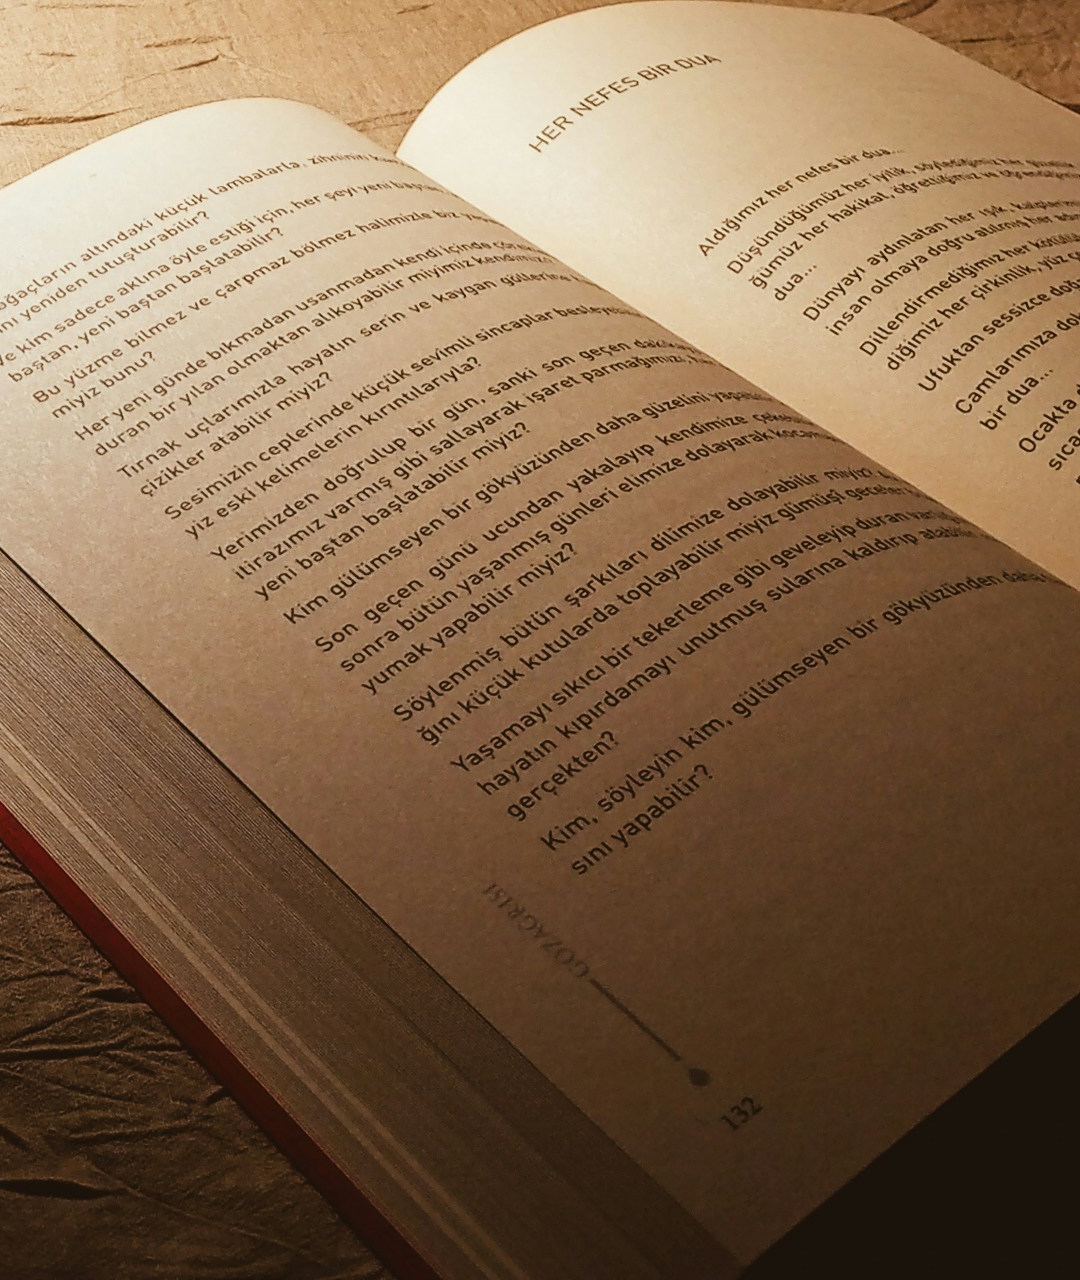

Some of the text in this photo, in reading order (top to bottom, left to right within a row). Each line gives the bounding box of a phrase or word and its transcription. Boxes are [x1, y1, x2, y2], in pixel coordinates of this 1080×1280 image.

[529, 51, 722, 153] HER NEFES BİR DUA
[153, 193, 209, 222] küçük
[698, 179, 794, 258] Aldığımız her
[726, 188, 847, 275] Düşündüğümüz
[839, 177, 871, 193] her
[747, 219, 830, 291] ğümüz her
[998, 244, 1032, 259] her
[7, 226, 284, 383] baştan, yeni baştan başlatabilir?
[773, 264, 818, 302] dua...
[802, 221, 949, 322] Dünyayı aydınlatan
[824, 294, 873, 337] insan
[870, 254, 930, 295] olmaya
[926, 232, 977, 258] doğru
[886, 263, 1043, 372] diğimiz her çirkinlik,
[31, 310, 188, 404] Bu yüzme bilmez
[51, 350, 156, 419] miyiz bunu?
[73, 309, 297, 442] Her yeni günde bıkmadan
[94, 325, 312, 457] duran bir yılan olmaktan
[115, 311, 407, 479] Tırnak uçlarımızla hayatın serin
[916, 293, 1052, 392] Ufuktan sessizce
[954, 329, 1059, 415] Camlarımıza
[978, 403, 1008, 431] bir
[1006, 368, 1054, 406] dua...
[139, 371, 334, 498] çizikler atabilir miyiz?
[163, 368, 413, 521] Sesimizin ceplerinde küçük
[184, 355, 482, 541] yiz eski kelimelerin kırıntılarıyla?
[209, 366, 539, 562] Yerimizden doğrulup bir gün, sanki
[323, 475, 394, 520] varmış
[392, 449, 430, 481] gibi
[428, 399, 528, 456] sallayarak
[1017, 398, 1079, 454] Ocakta
[253, 421, 532, 603] yeni baştan başlatabilir miyiz?
[282, 431, 597, 625] Kim gülümseyen bir gökyüzünden
[314, 443, 656, 654] Son geçen günü ucundan yakalayıp
[339, 457, 687, 673] sonra bütün yaşanmış günleri elimize
[360, 541, 579, 697] yumak yapabilir miyiz?
[392, 509, 726, 723] Söylenmiş bütün şarkıları dilimize
[448, 524, 858, 773] Yaşamayı sıkıcı bir tekerleme gibi geveleyip
[455, 667, 526, 715] küçük
[518, 603, 621, 671] kutularda
[615, 537, 725, 606] toplayabilir
[724, 511, 781, 543] miyiz
[475, 556, 848, 797] hayatın kıpırdamayı unutmuş sularına
[538, 617, 880, 852] Kim, söyleyin kim, gülümseyen bir
[506, 730, 621, 823] gerçekten?
[570, 763, 714, 876] sını yapabilir?
[720, 1095, 764, 1131] 132
